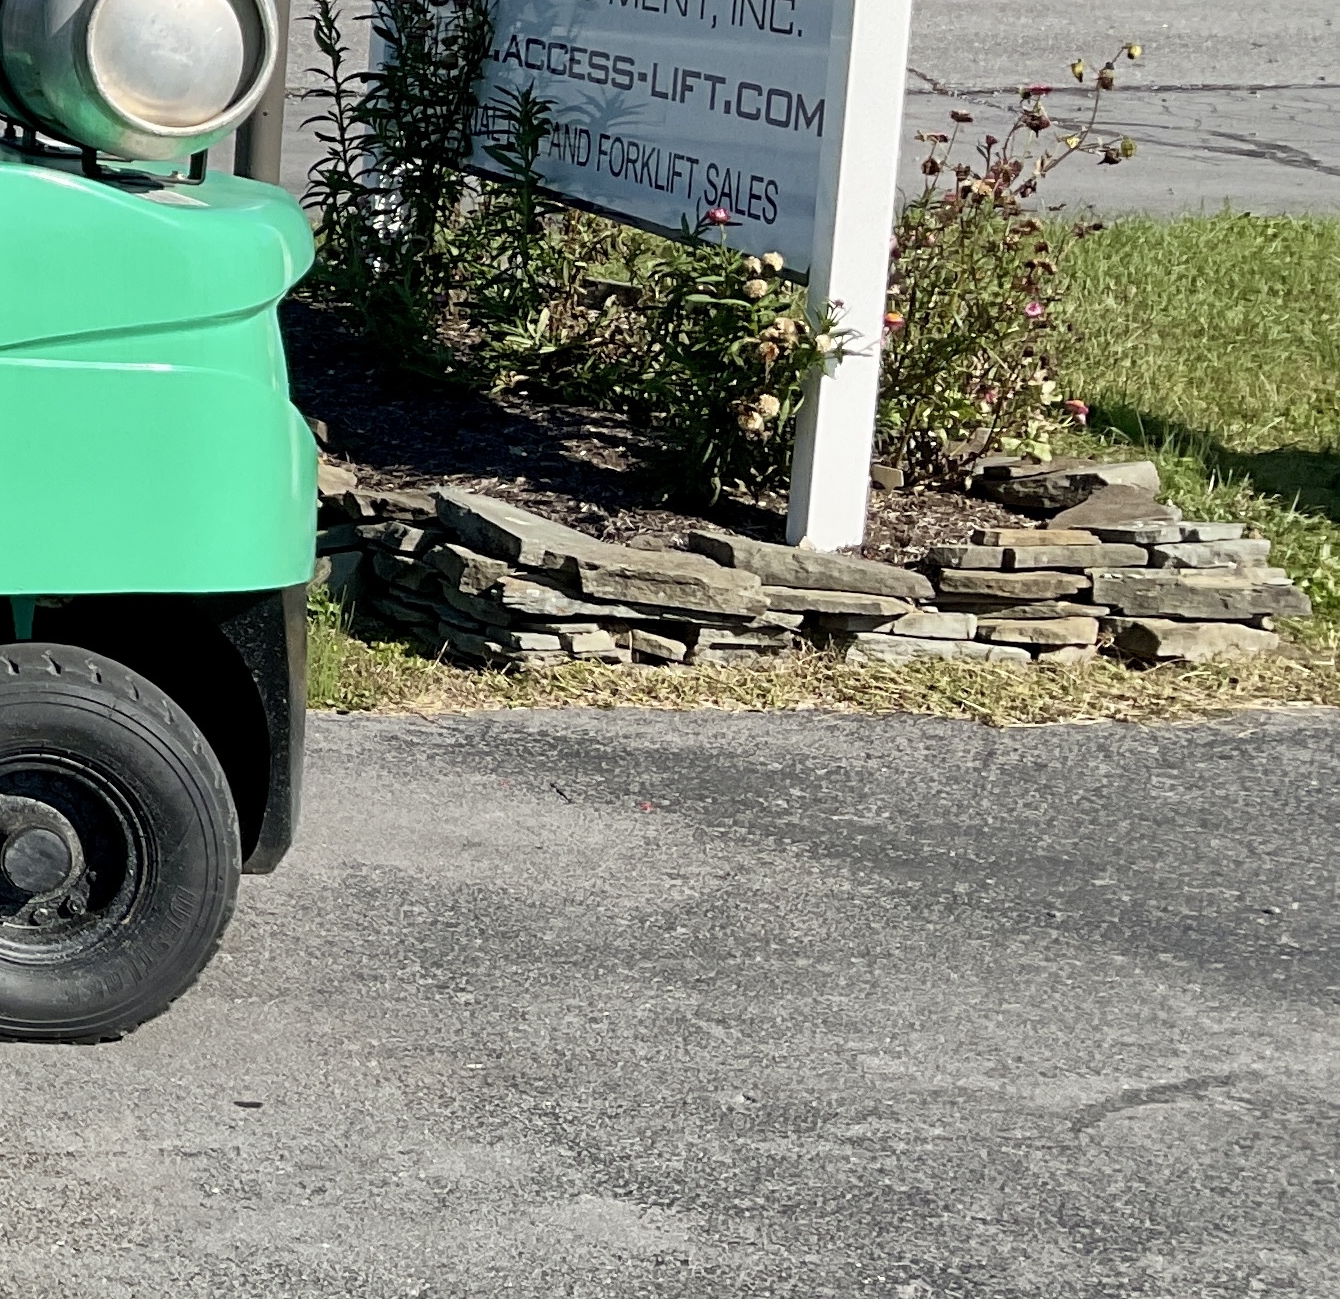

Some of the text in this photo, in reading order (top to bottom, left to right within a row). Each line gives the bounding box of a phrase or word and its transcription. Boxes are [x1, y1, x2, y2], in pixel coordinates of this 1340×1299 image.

[492, 34, 826, 138] .ACCESS-LIFT.COM
[547, 121, 591, 167] AND
[596, 132, 699, 200] FORKLIFT
[703, 162, 779, 225] SALES
